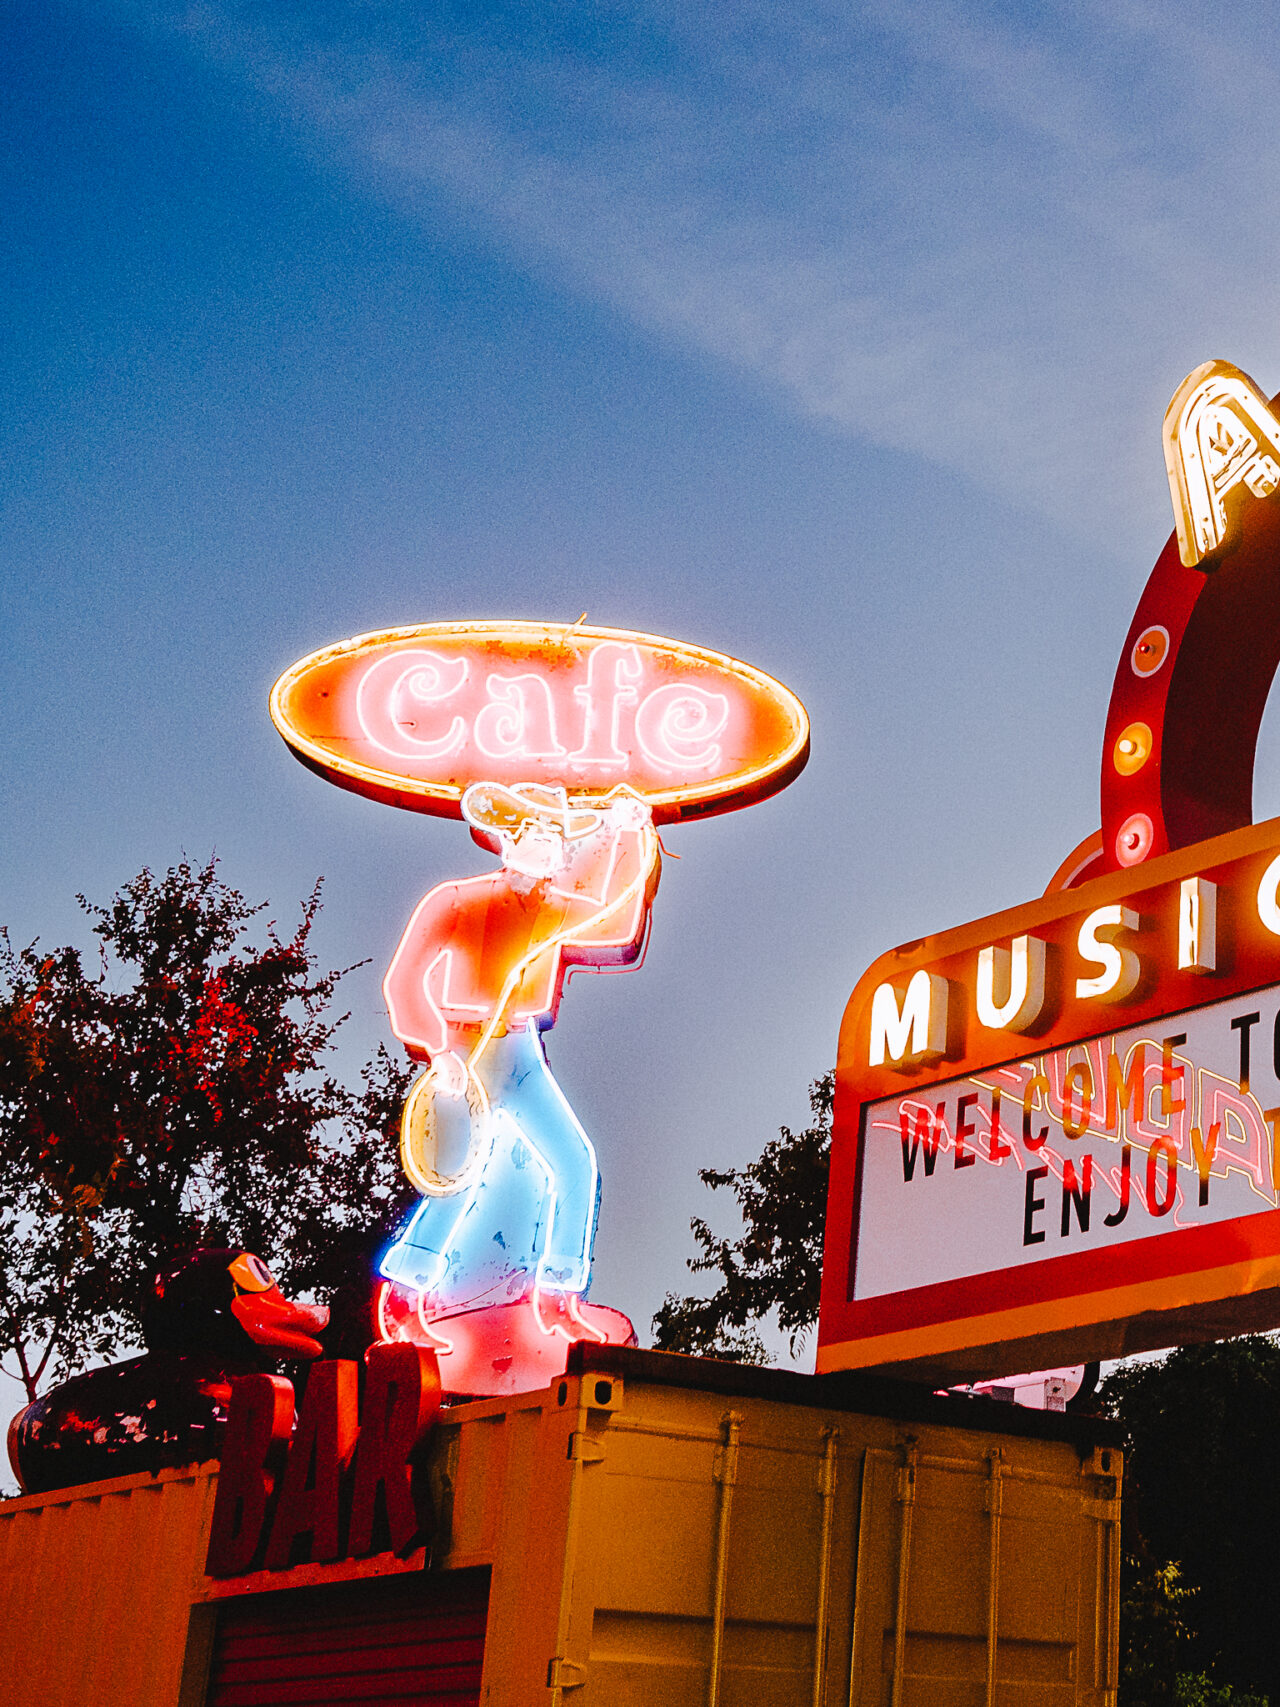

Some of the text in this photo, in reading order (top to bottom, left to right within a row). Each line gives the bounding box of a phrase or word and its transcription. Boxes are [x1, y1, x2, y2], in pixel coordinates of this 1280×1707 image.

[356, 641, 730, 772] Cafe
[900, 1033, 1188, 1182] WELCOME
[1022, 1122, 1221, 1247] ENJOY
[204, 1341, 441, 1577] BAR
